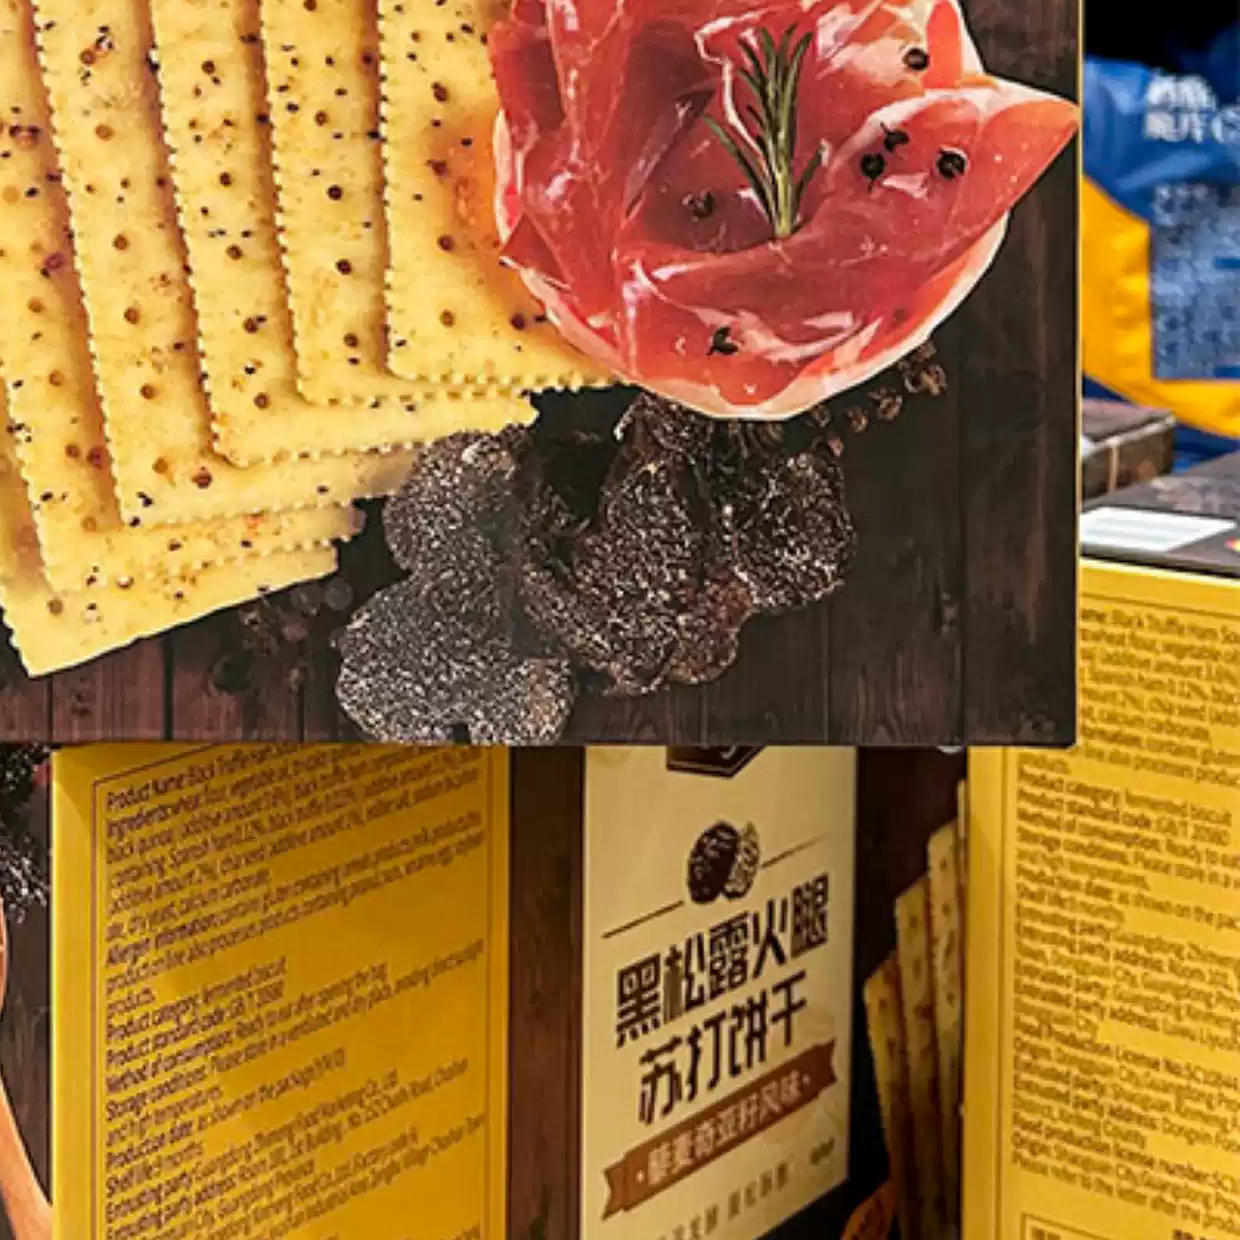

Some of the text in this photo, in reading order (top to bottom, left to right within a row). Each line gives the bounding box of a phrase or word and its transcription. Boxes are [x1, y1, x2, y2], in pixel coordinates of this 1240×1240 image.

[614, 873, 830, 1049] 黑松露火腿
[638, 970, 807, 1125] 苏打饼干
